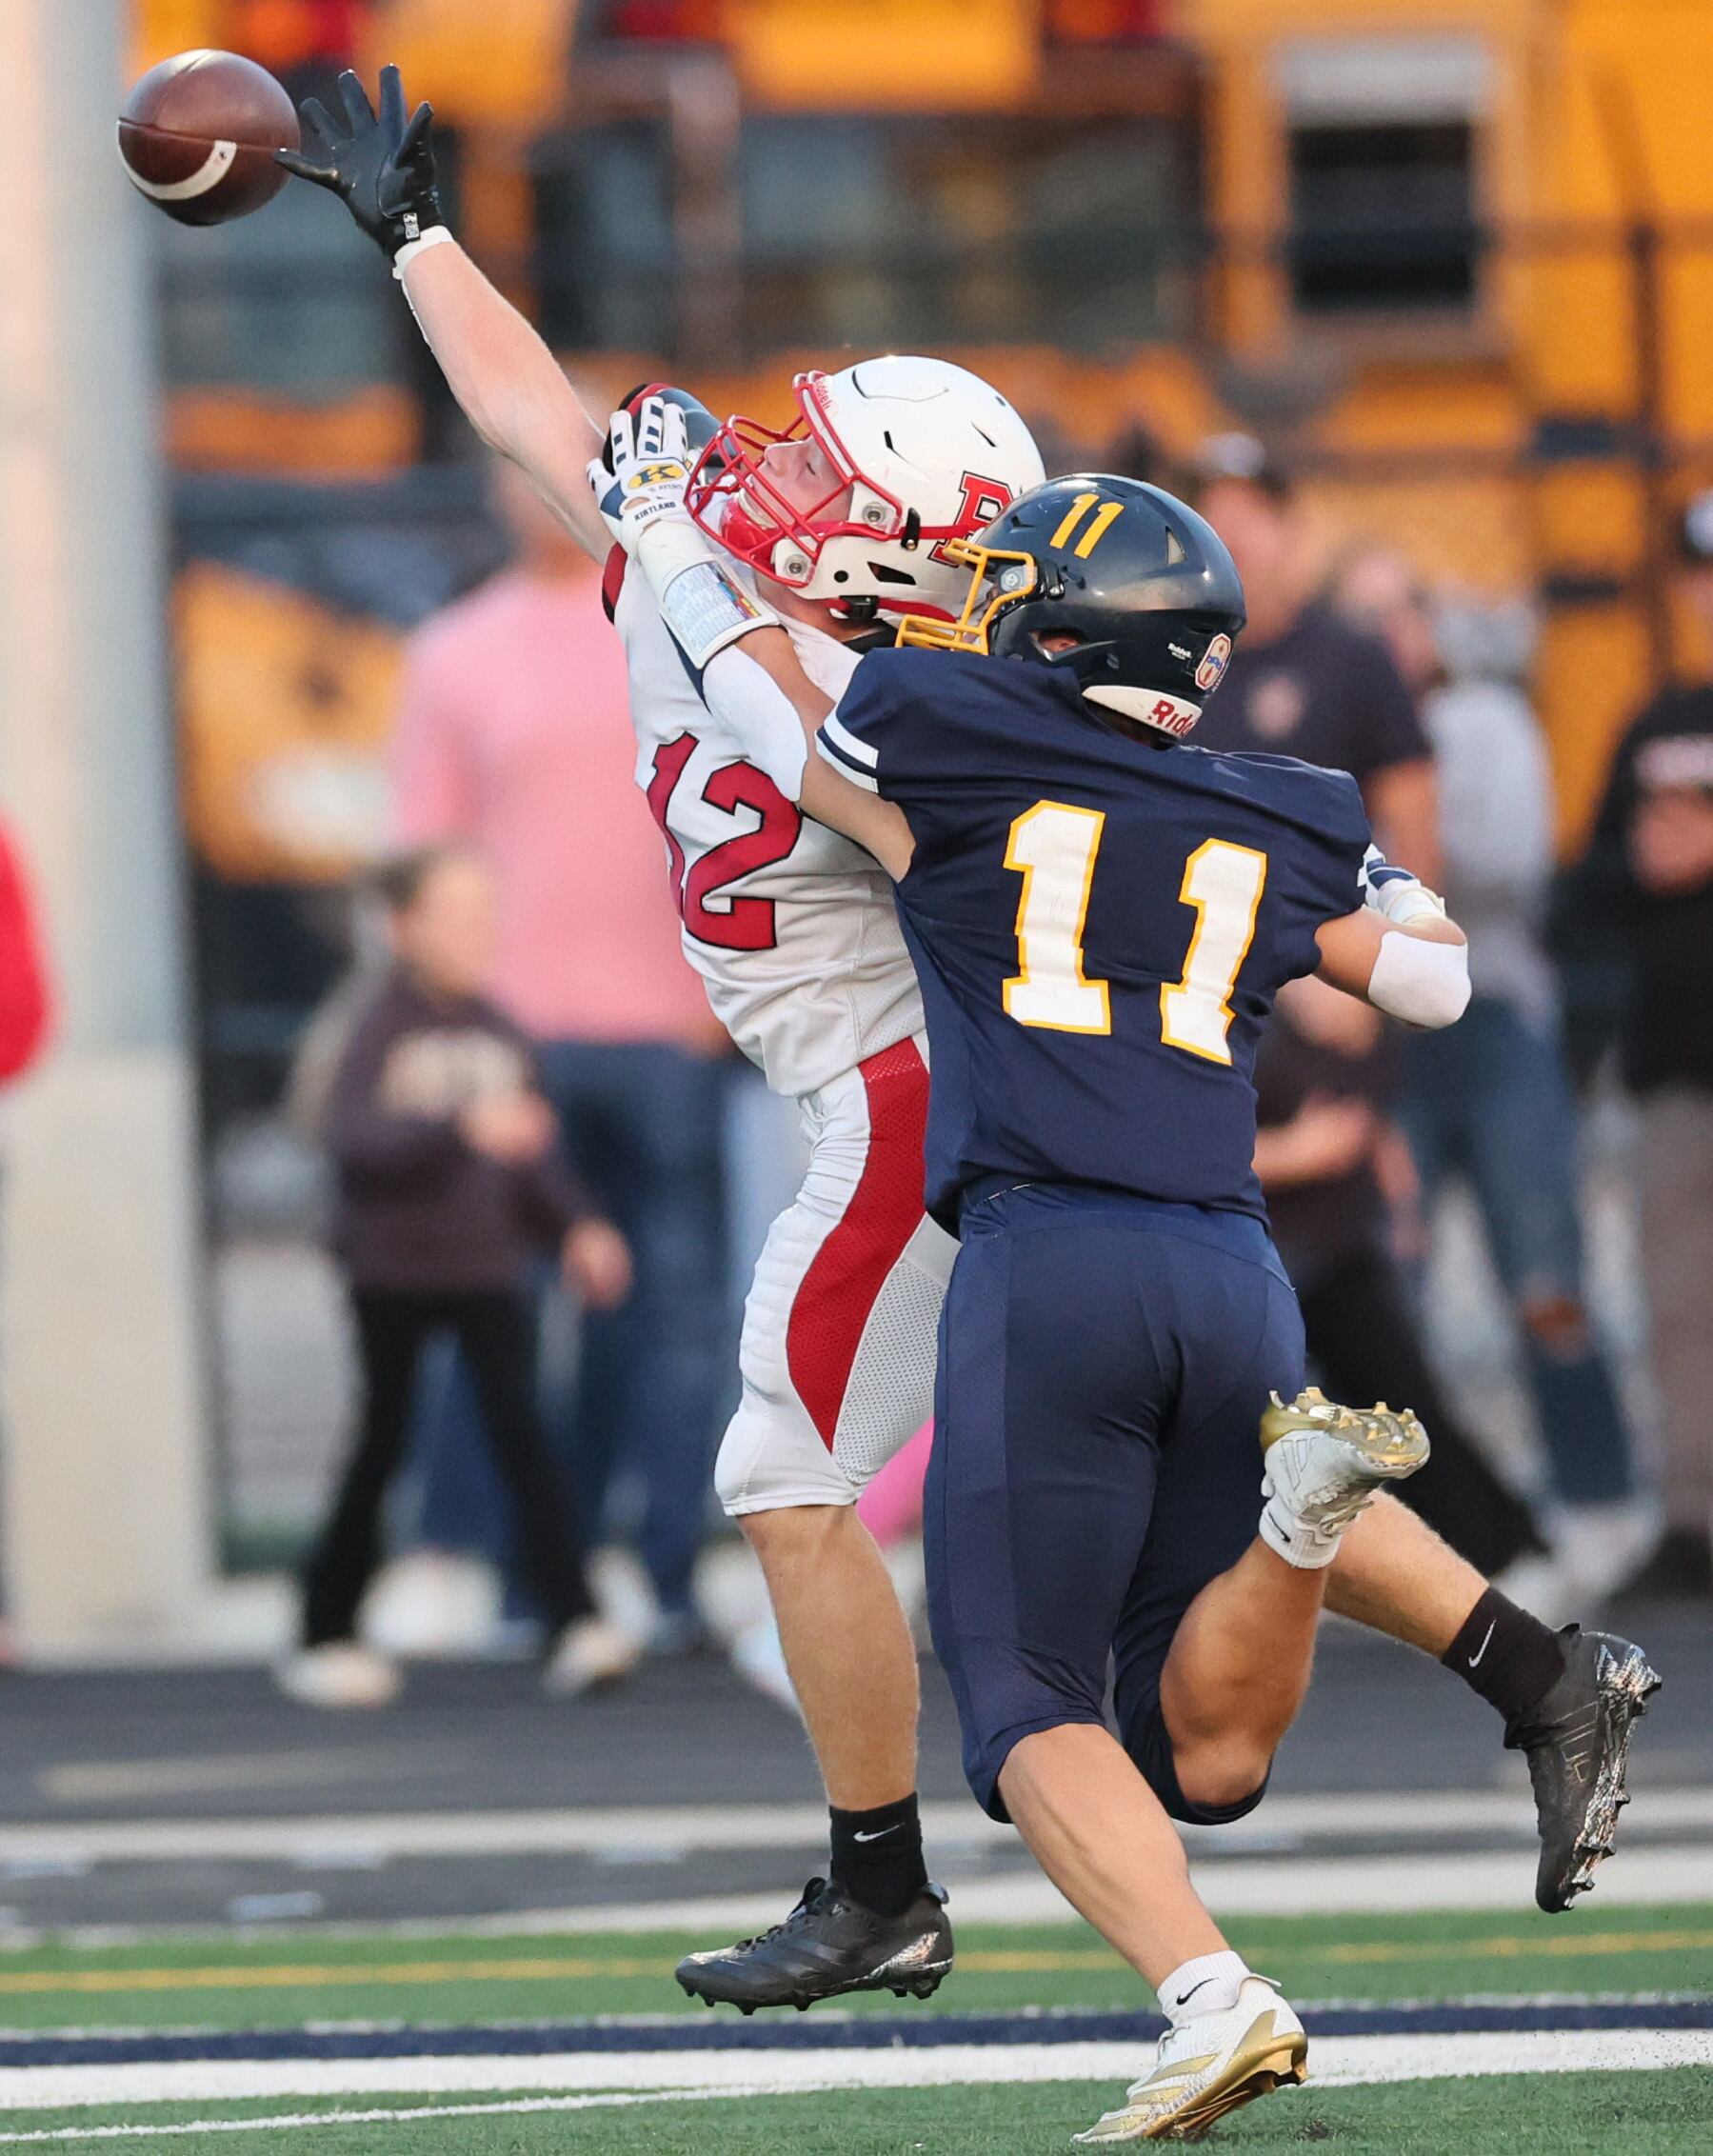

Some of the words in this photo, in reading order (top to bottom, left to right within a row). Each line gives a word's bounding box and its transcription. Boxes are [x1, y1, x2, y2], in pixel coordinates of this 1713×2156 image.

[637, 464, 676, 487] K
[634, 501, 676, 521] KIRTLAND
[1049, 493, 1125, 560] 11
[647, 729, 803, 950] 12
[1003, 799, 1267, 1067] 11
